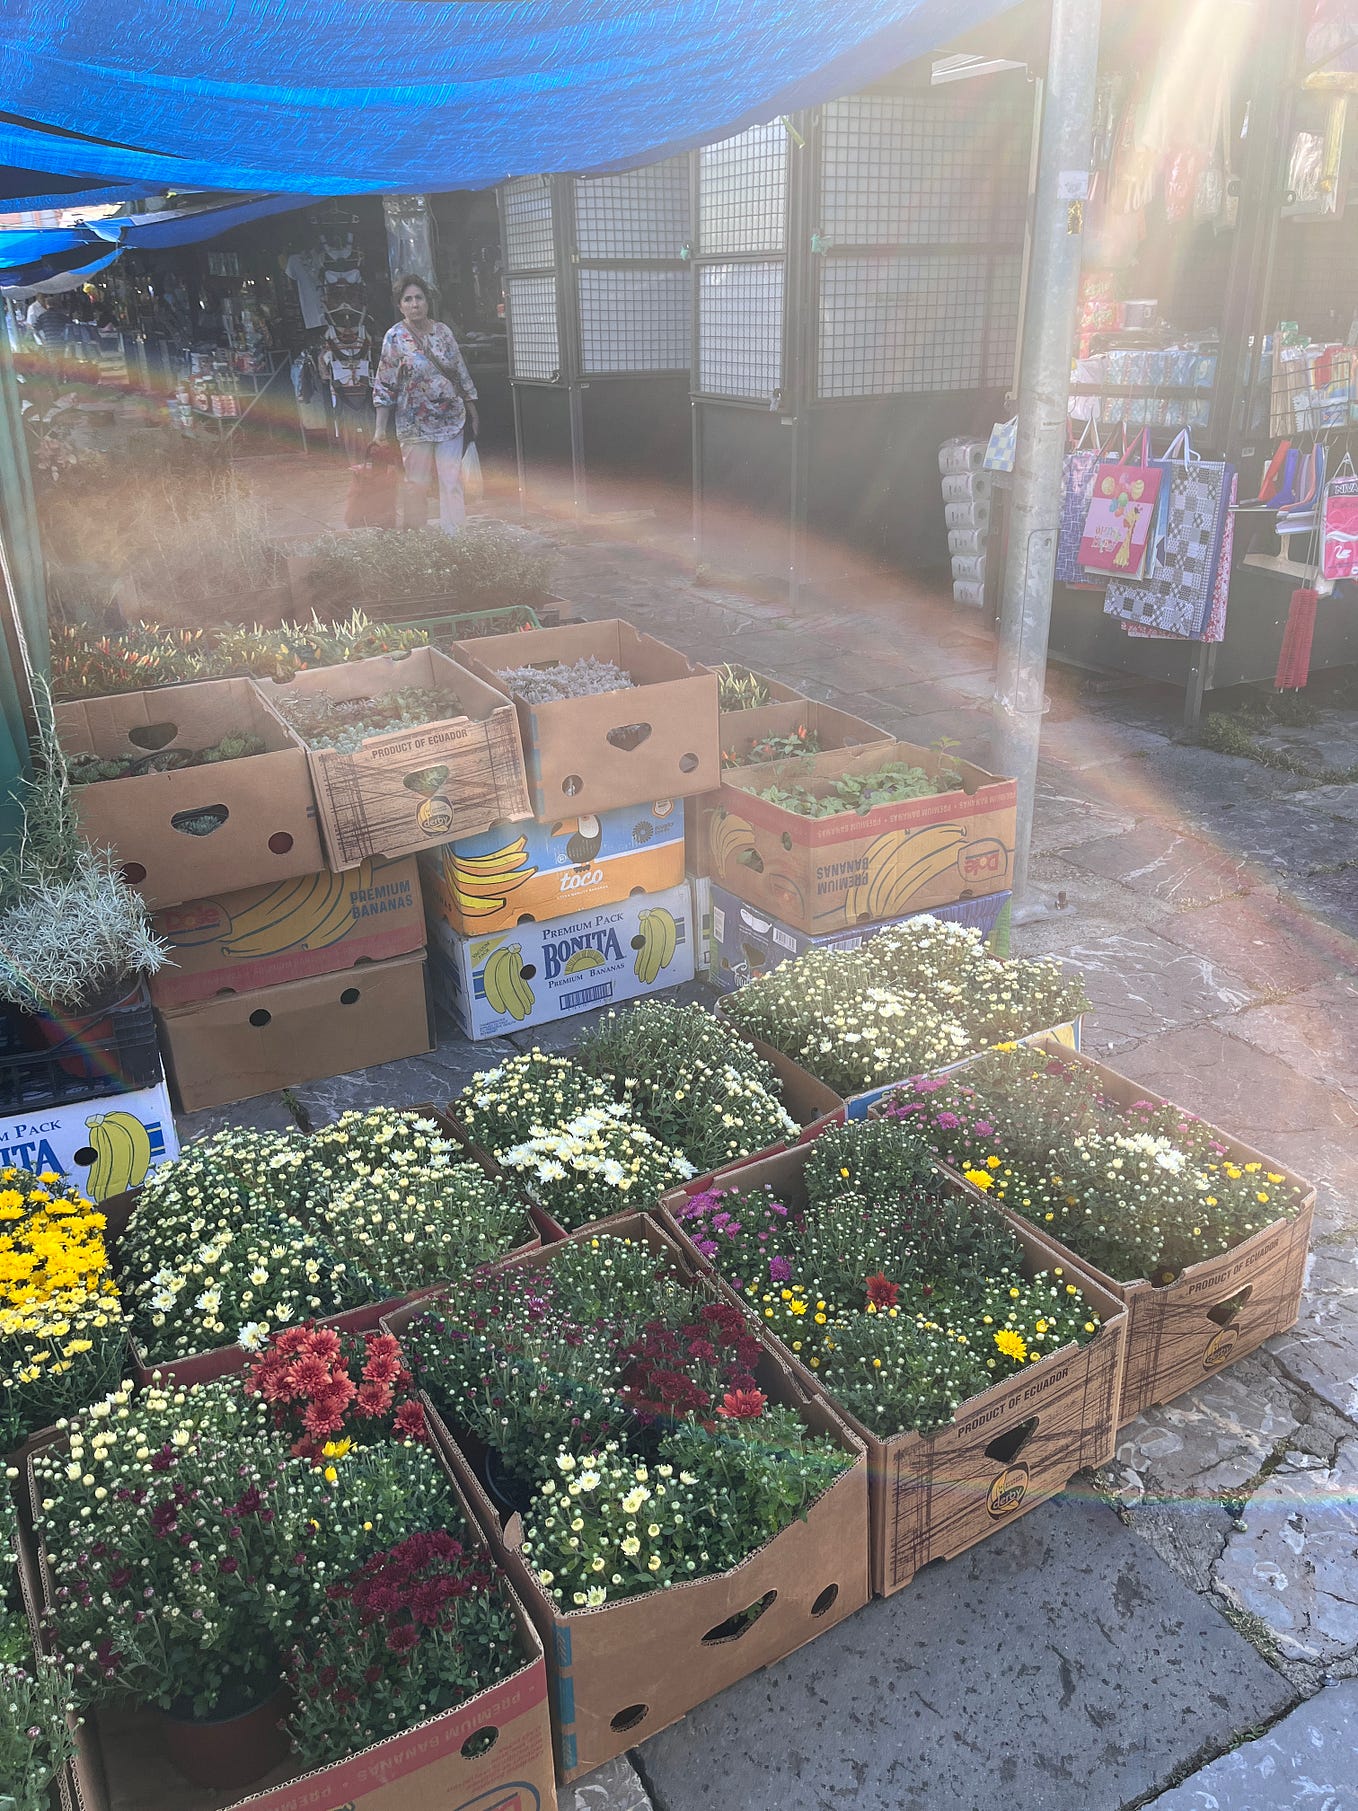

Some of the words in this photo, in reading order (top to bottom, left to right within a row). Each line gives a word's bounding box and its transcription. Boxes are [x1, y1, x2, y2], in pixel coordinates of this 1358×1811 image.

[372, 741, 412, 759] PRODUCT
[414, 738, 426, 749] OF
[428, 729, 468, 746] ECUADOR
[423, 813, 451, 829] derby
[816, 856, 870, 879] BANANAS
[964, 854, 999, 877] Dole
[350, 880, 411, 905] PREMIUM
[559, 869, 604, 892] toco
[817, 872, 869, 895] PREMIUM
[352, 895, 413, 920] BANANAS
[542, 921, 593, 941] PREMIUM
[595, 912, 625, 928] PACK
[541, 926, 627, 981] BONITA
[548, 973, 583, 989] PREMIUM
[589, 962, 625, 978] BANANAS
[14, 1119, 62, 1139] PACK
[1188, 1272, 1232, 1295] PRODUCT
[1233, 1263, 1244, 1276] OF
[1245, 1238, 1279, 1268] ECUADOR
[957, 1403, 1006, 1438] PRODUCT
[1008, 1394, 1022, 1409] OF
[1023, 1368, 1069, 1401] ECUADOR
[992, 1485, 1025, 1511] derby
[445, 1692, 521, 1741] PREMIUM
[357, 1735, 440, 1781] BANANAS
